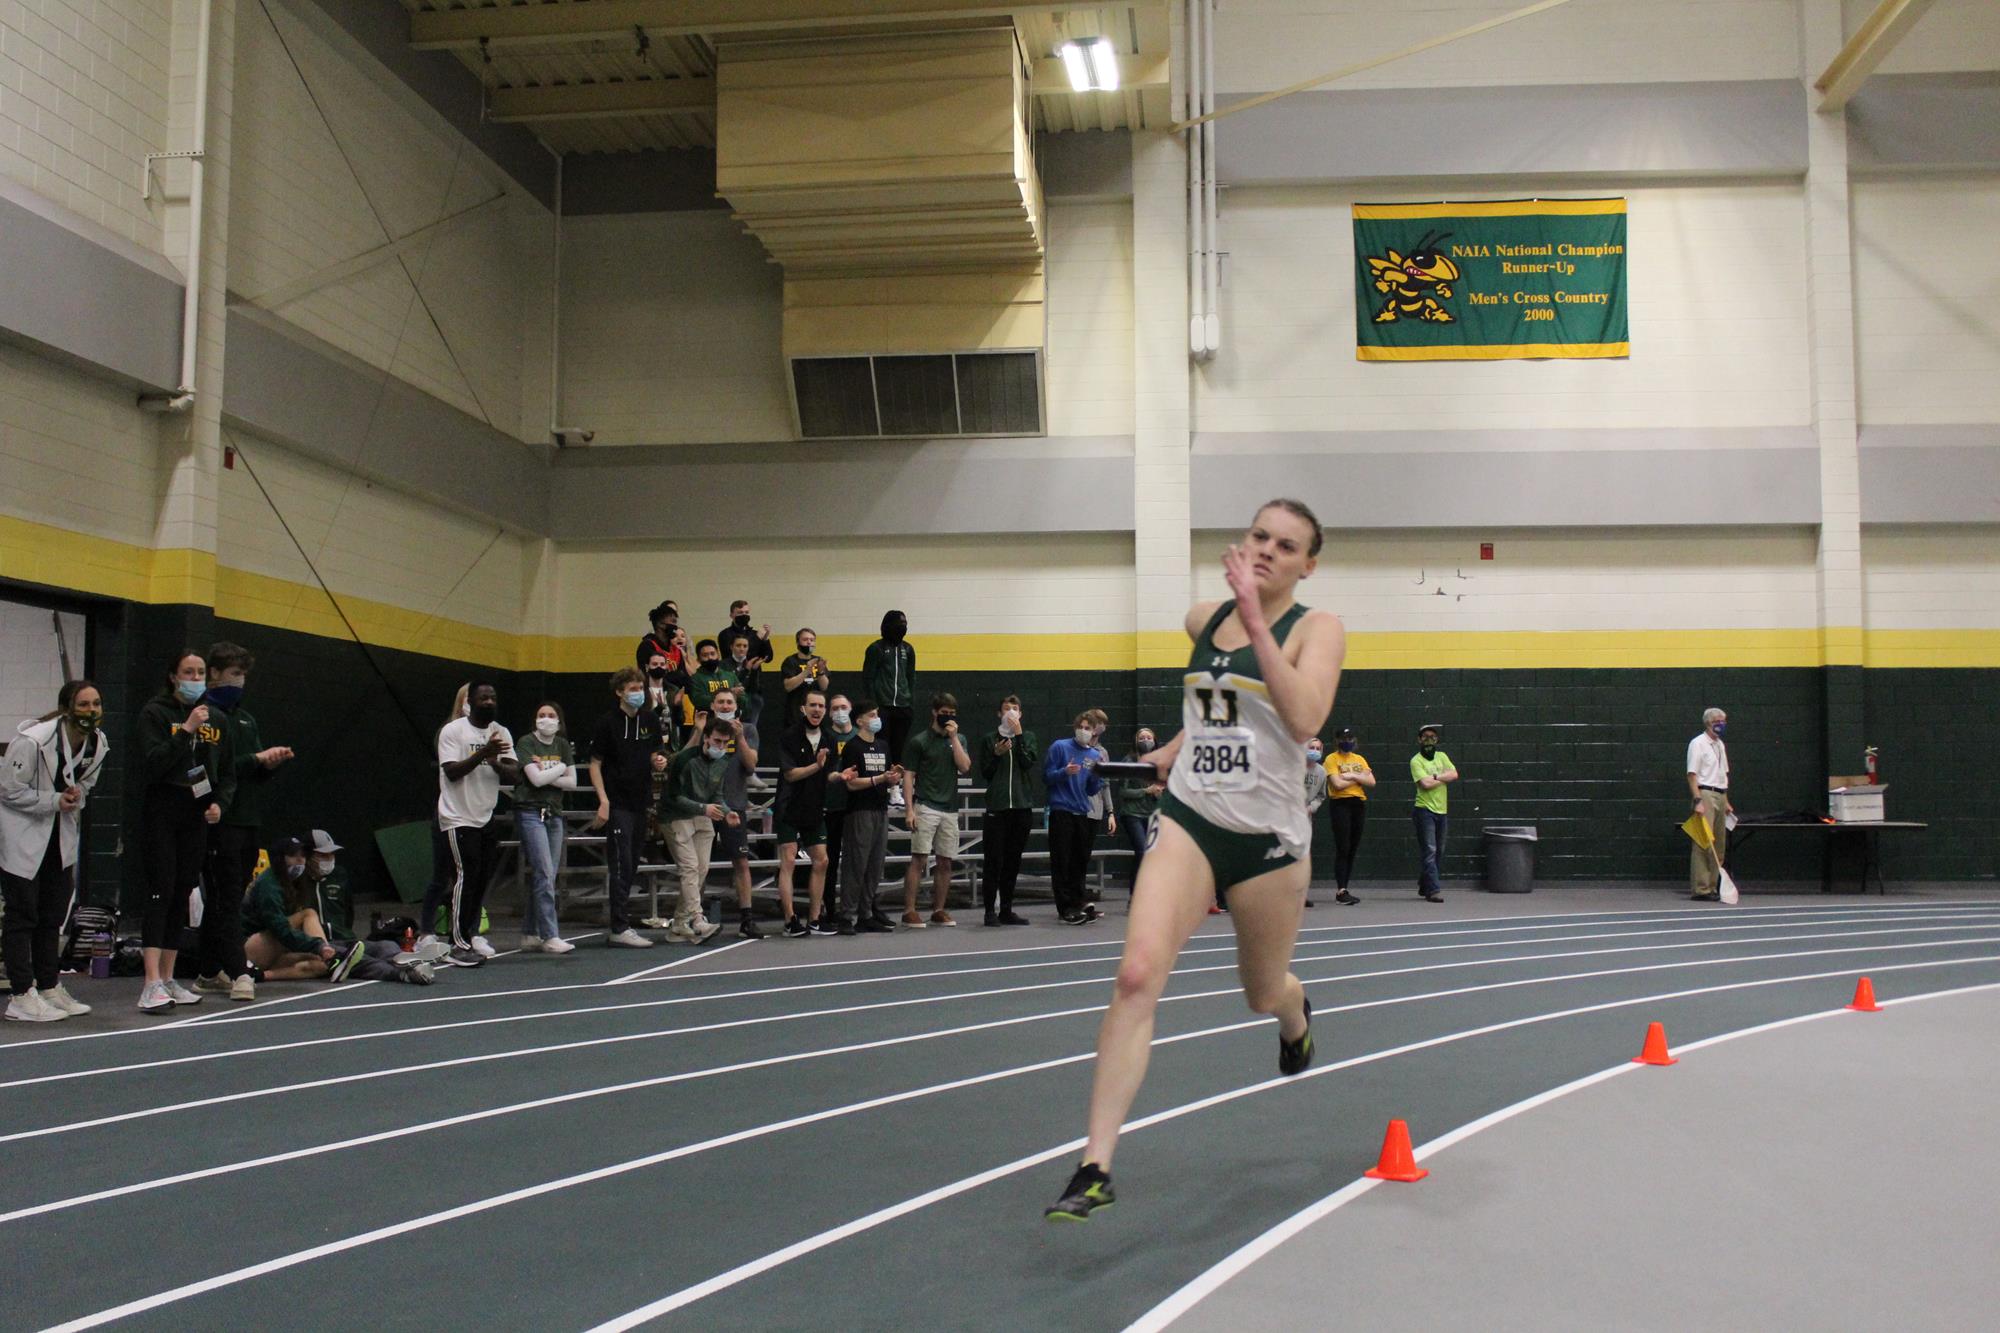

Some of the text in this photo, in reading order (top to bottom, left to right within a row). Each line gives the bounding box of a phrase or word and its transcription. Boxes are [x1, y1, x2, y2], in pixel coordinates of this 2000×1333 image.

[1452, 242, 1623, 257] NAIA National Champion
[1502, 261, 1575, 275] Runner-Up
[1469, 290, 1608, 305] Men's Cross Country
[1524, 308, 1555, 321] 2000
[1192, 745, 1250, 774] 2984
